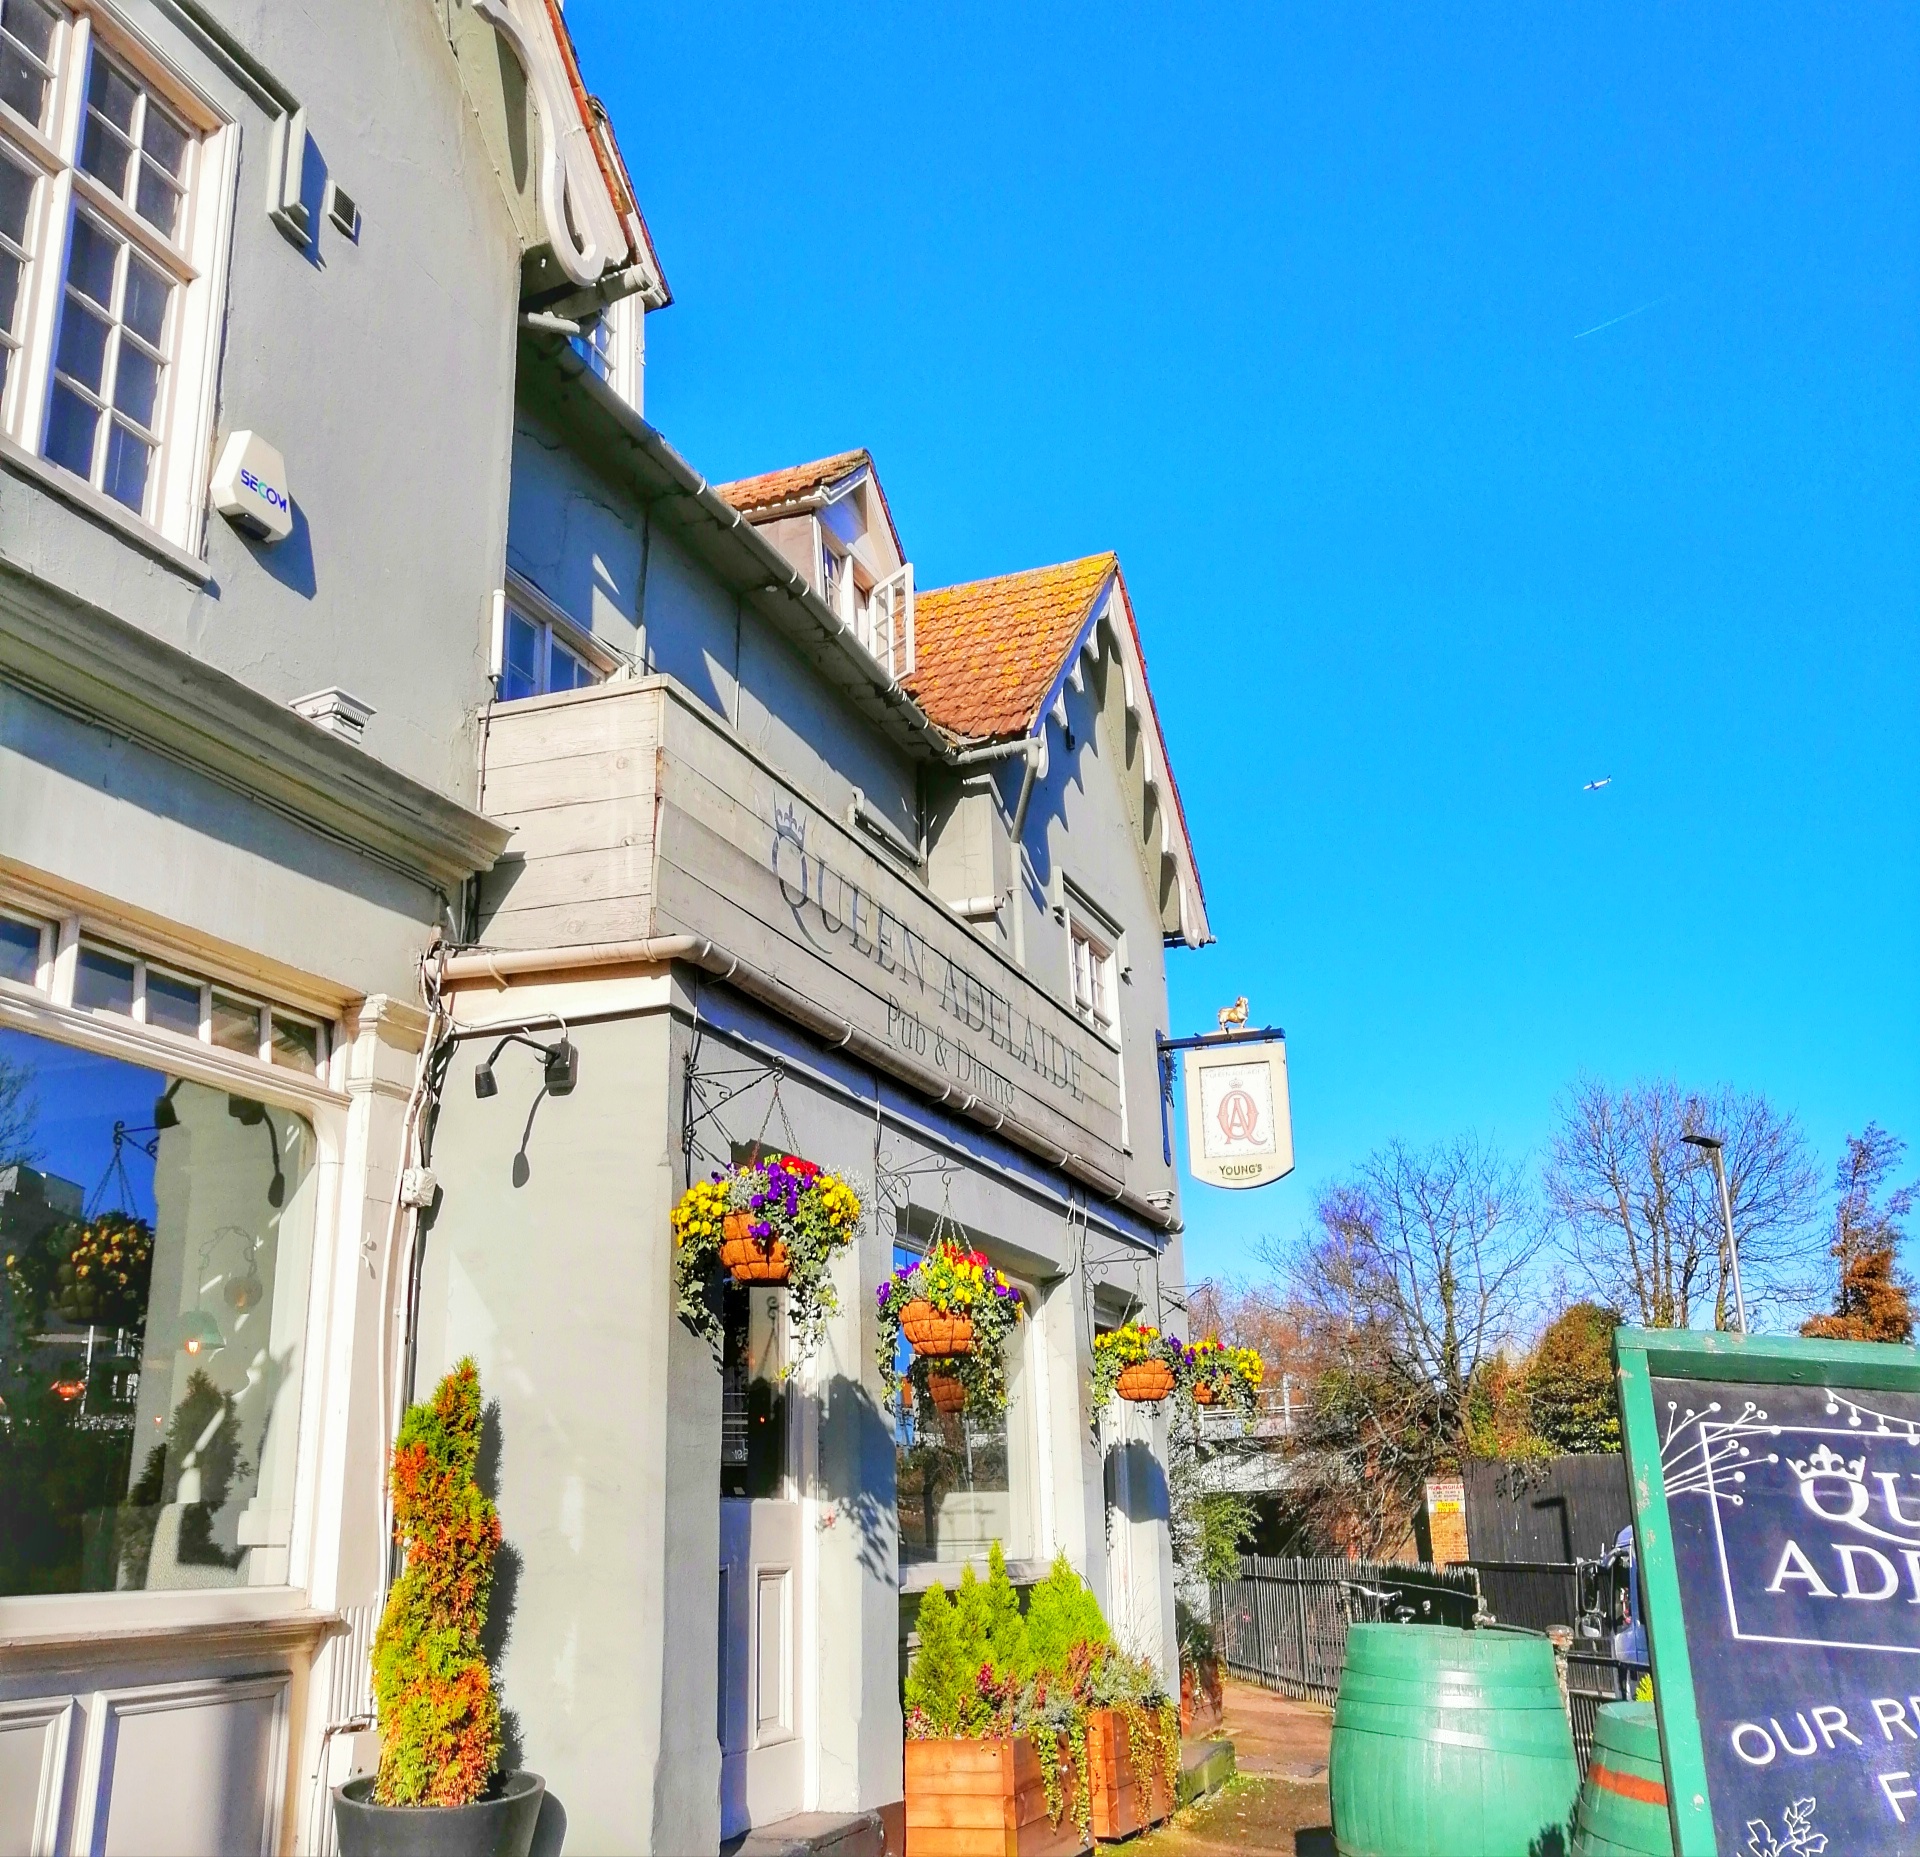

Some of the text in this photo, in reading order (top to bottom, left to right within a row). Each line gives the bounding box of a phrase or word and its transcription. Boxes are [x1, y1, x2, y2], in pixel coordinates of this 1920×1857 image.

[240, 468, 287, 514] SECOM
[771, 833, 1086, 1104] QUEEN ADELAIDE
[886, 991, 1016, 1117] Pub & Dining
[1219, 1163, 1263, 1176] YOUNG'S
[1731, 1705, 1863, 1765] OUR
